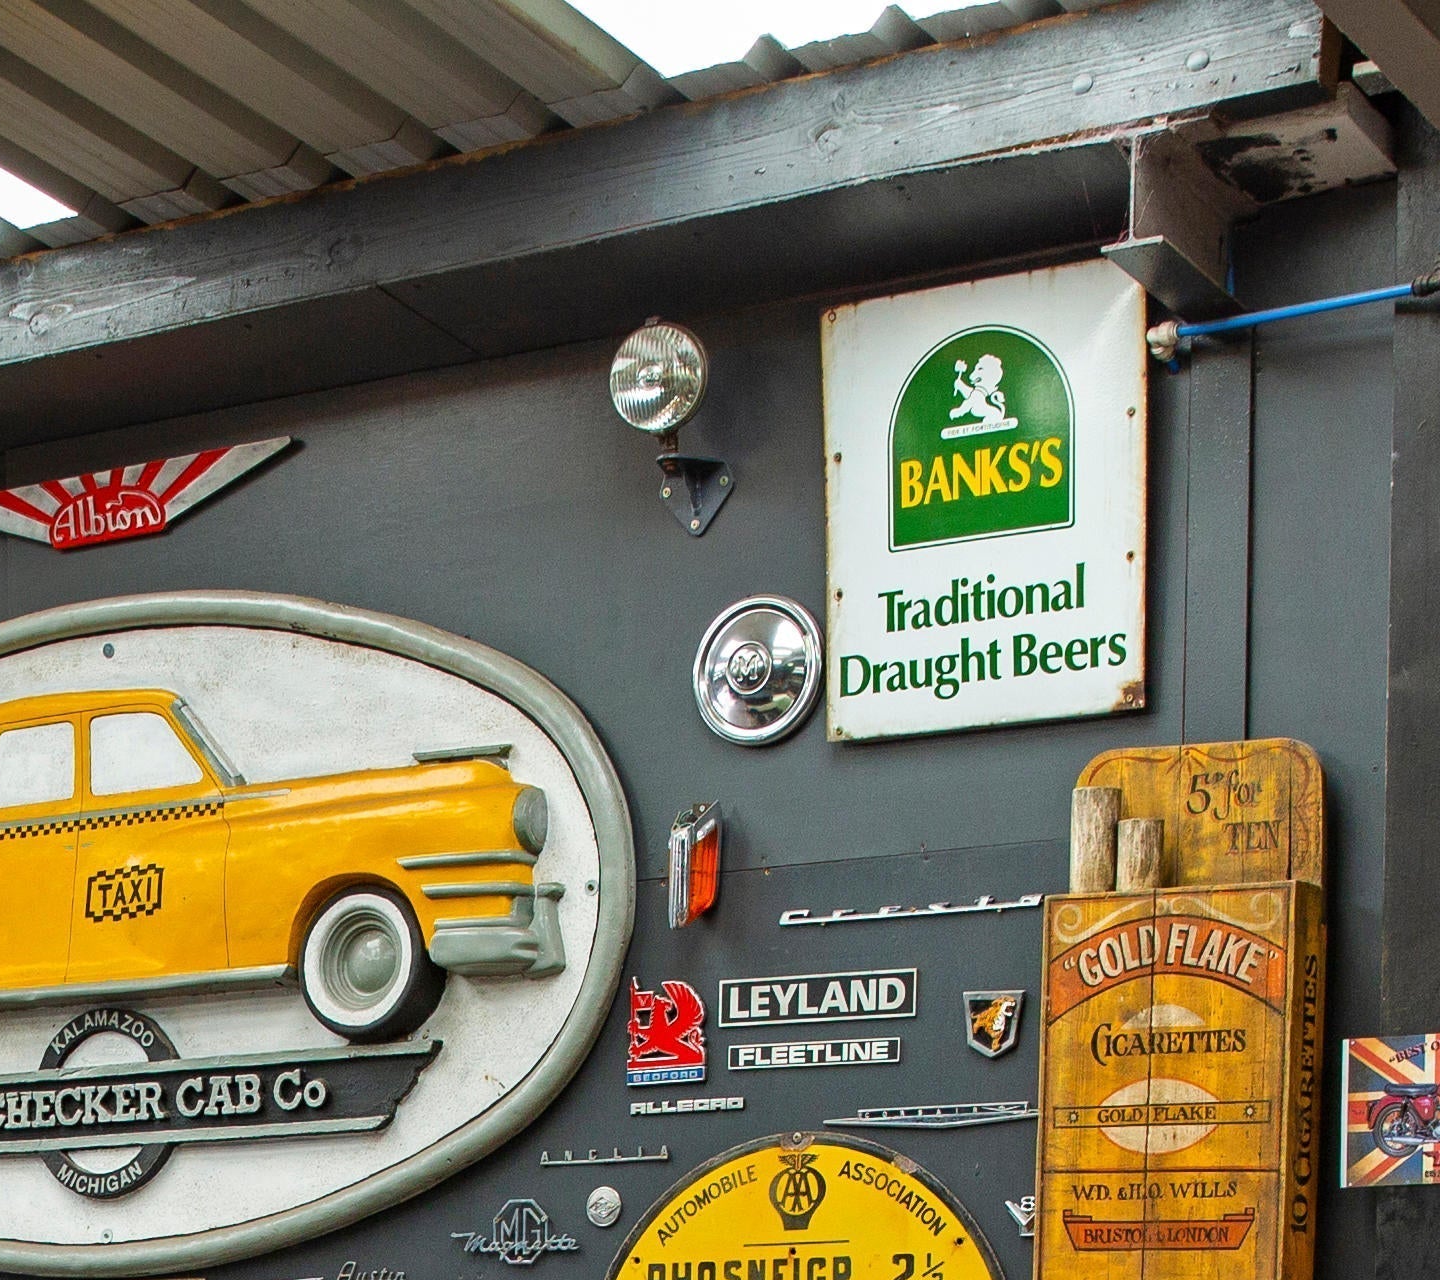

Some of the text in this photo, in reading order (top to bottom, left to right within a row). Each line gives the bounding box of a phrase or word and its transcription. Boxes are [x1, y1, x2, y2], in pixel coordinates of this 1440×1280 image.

[901, 437, 1063, 508] BANKS'S
[54, 488, 164, 546] Albion
[879, 562, 1086, 632] Traditional
[840, 631, 1127, 700] Draught Beers
[1226, 819, 1282, 854] TEN
[98, 870, 158, 914] TAXI
[728, 977, 905, 1019] LEYLAND
[50, 1012, 156, 1057] KALAMAZOO
[738, 1040, 890, 1066] FLEETLINE
[1091, 1022, 1247, 1067] CIGARETTES
[174, 1069, 264, 1119] CAB
[1299, 953, 1321, 1192] CIGARETTES
[1097, 1104, 1218, 1125] GOLD FLAKE
[57, 1161, 144, 1195] MICHIGAN
[1169, 1180, 1238, 1199] WILLS
[658, 1160, 946, 1247] AUTOMOBILE ASSOCIATION
